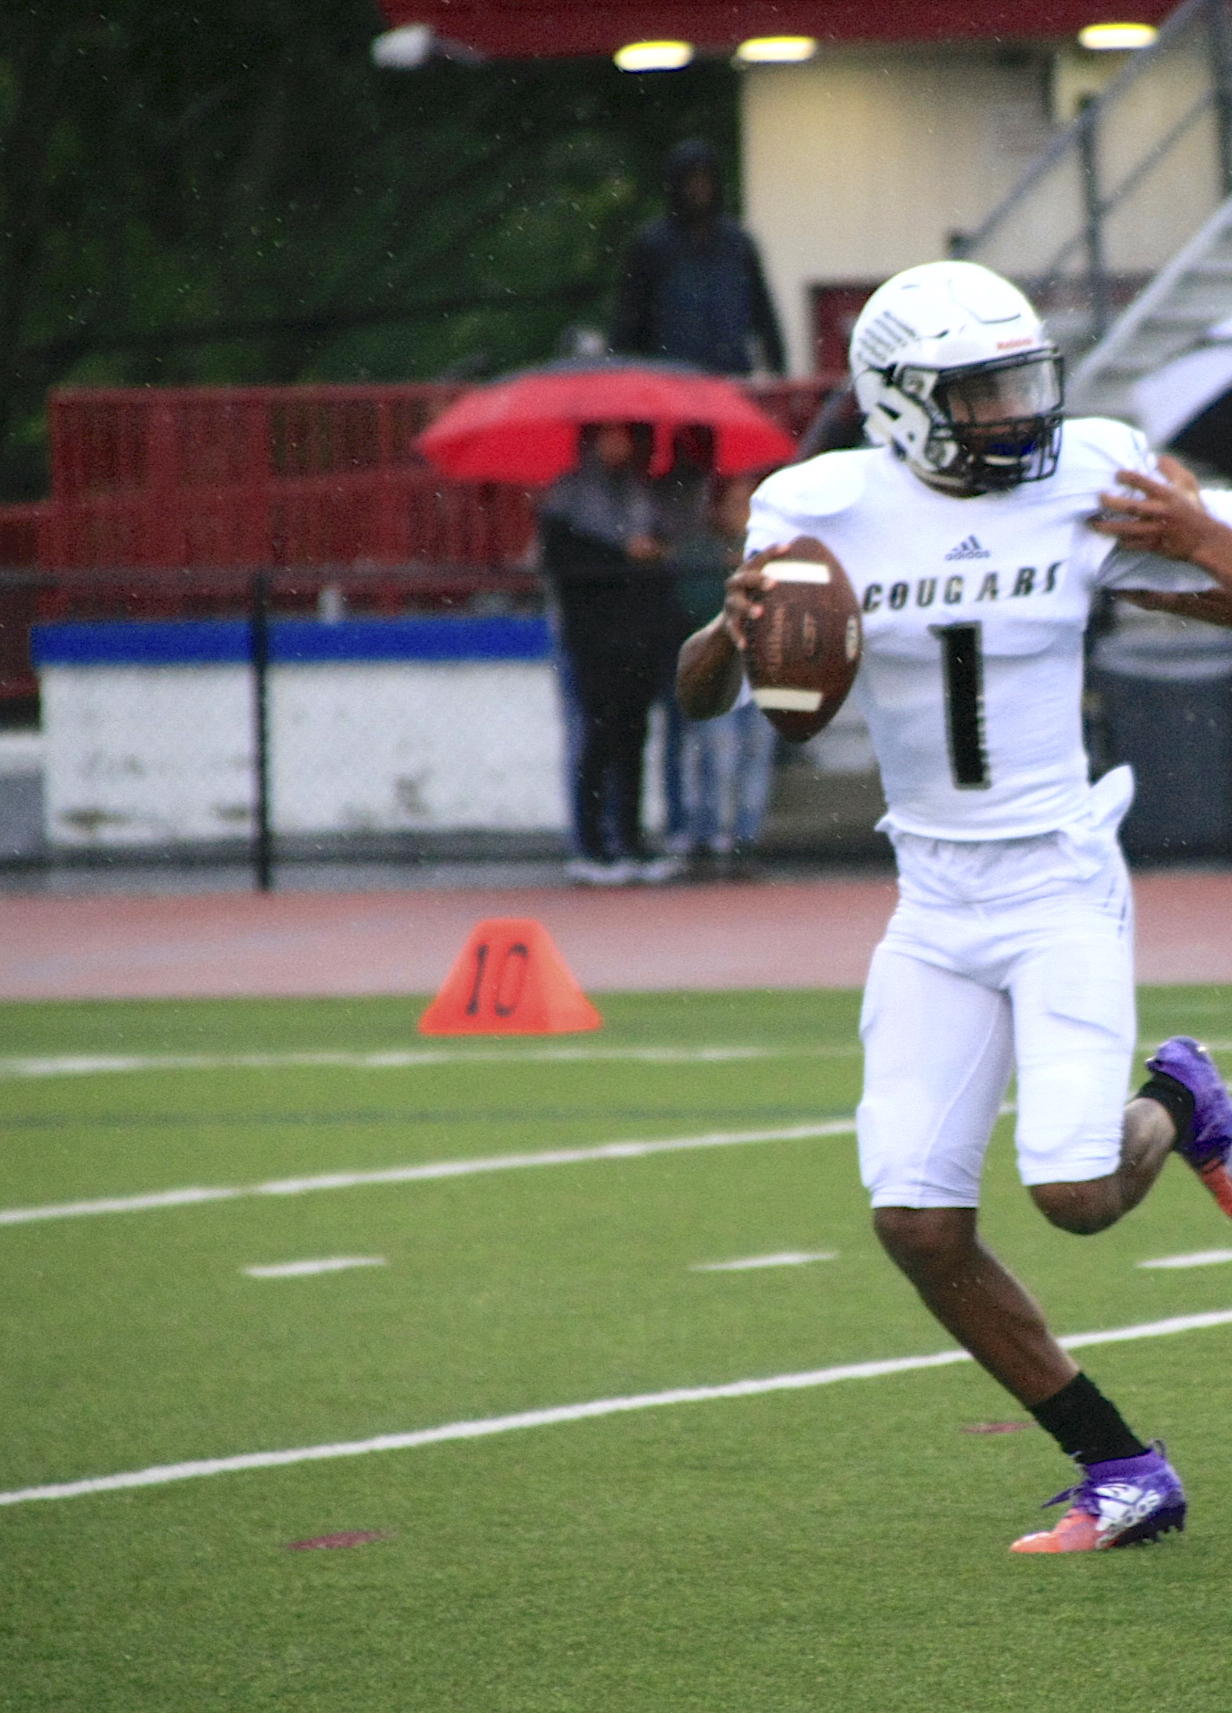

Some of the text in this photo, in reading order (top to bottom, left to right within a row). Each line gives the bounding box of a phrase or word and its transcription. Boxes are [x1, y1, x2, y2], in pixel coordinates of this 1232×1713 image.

[863, 561, 1063, 614] COUGARS
[927, 620, 992, 791] 1
[466, 942, 530, 1018] 10
